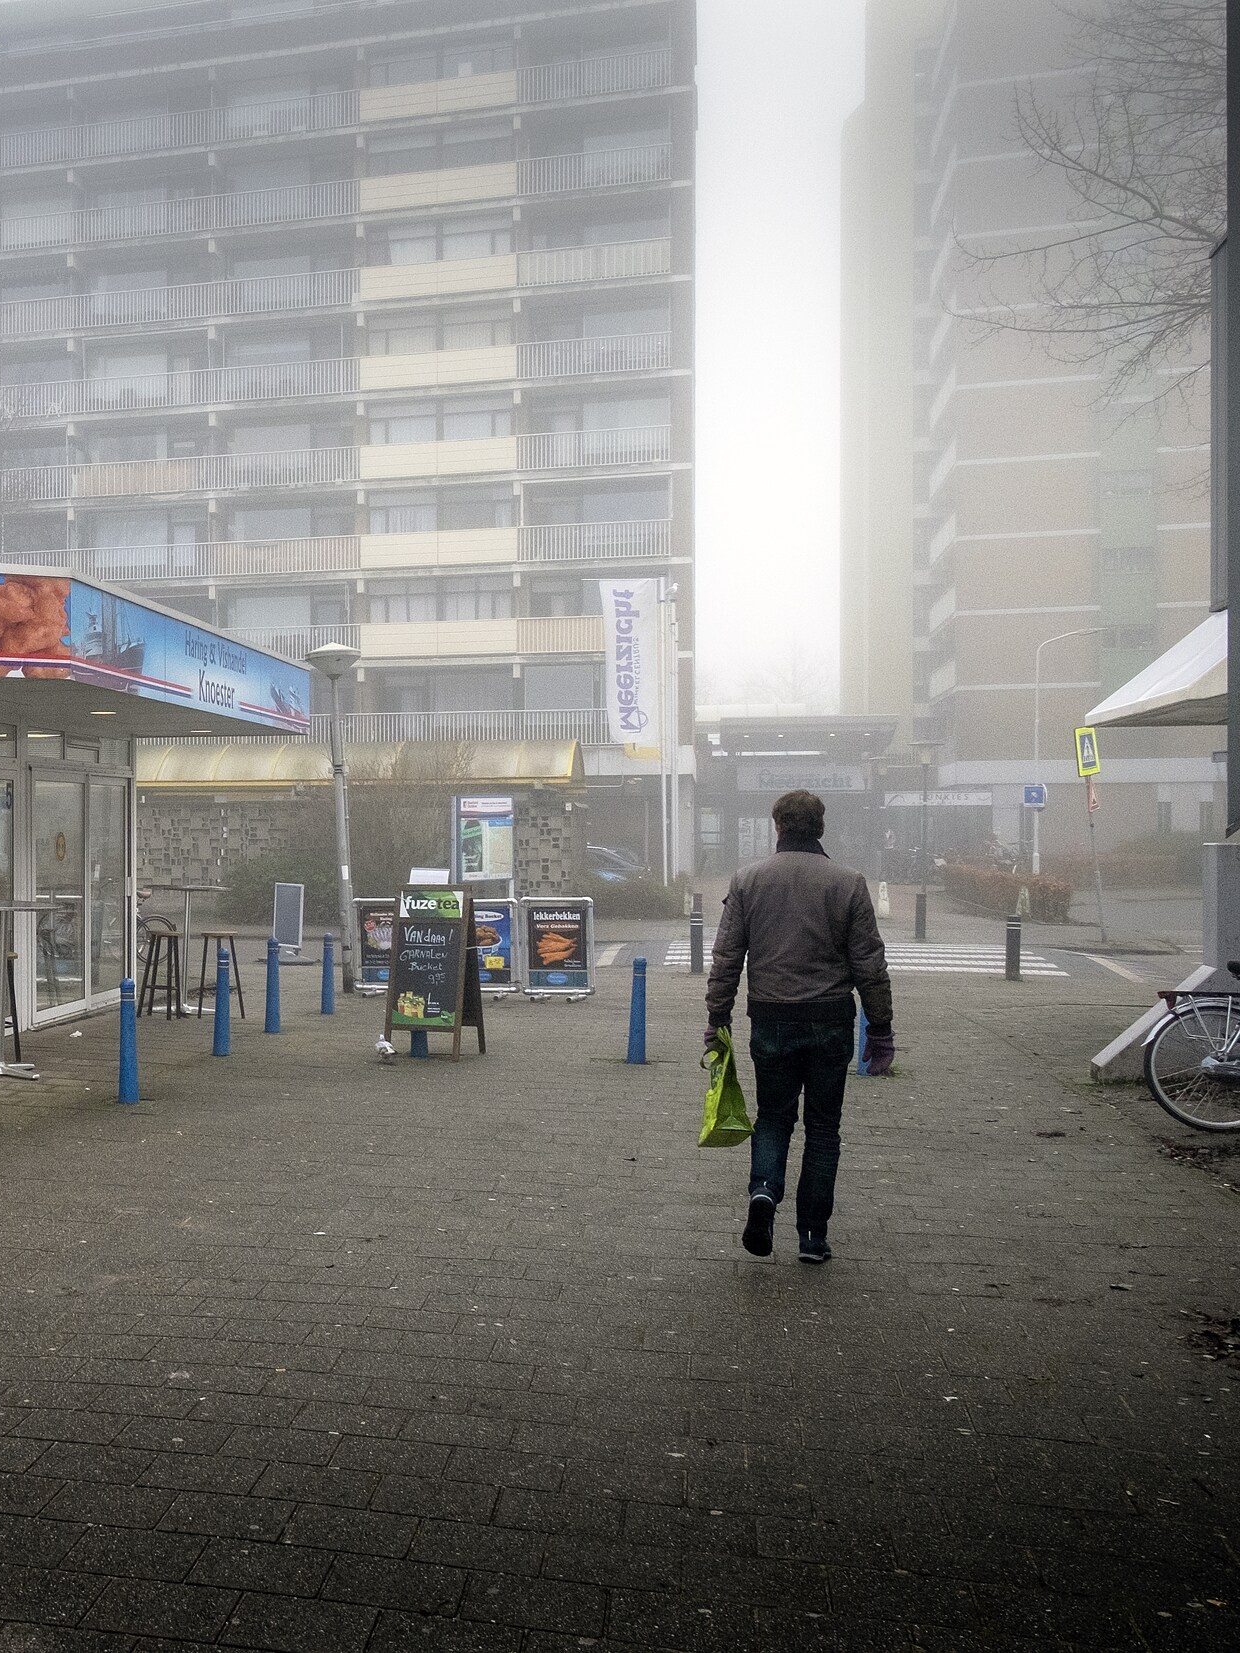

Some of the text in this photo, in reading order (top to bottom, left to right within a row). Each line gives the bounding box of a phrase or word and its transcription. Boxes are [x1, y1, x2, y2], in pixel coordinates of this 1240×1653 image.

[184, 629, 247, 675] Haring & Vishandel
[198, 668, 235, 709] Knoester
[405, 895, 460, 910] fuzetea
[533, 911, 581, 921] lekkerbekken
